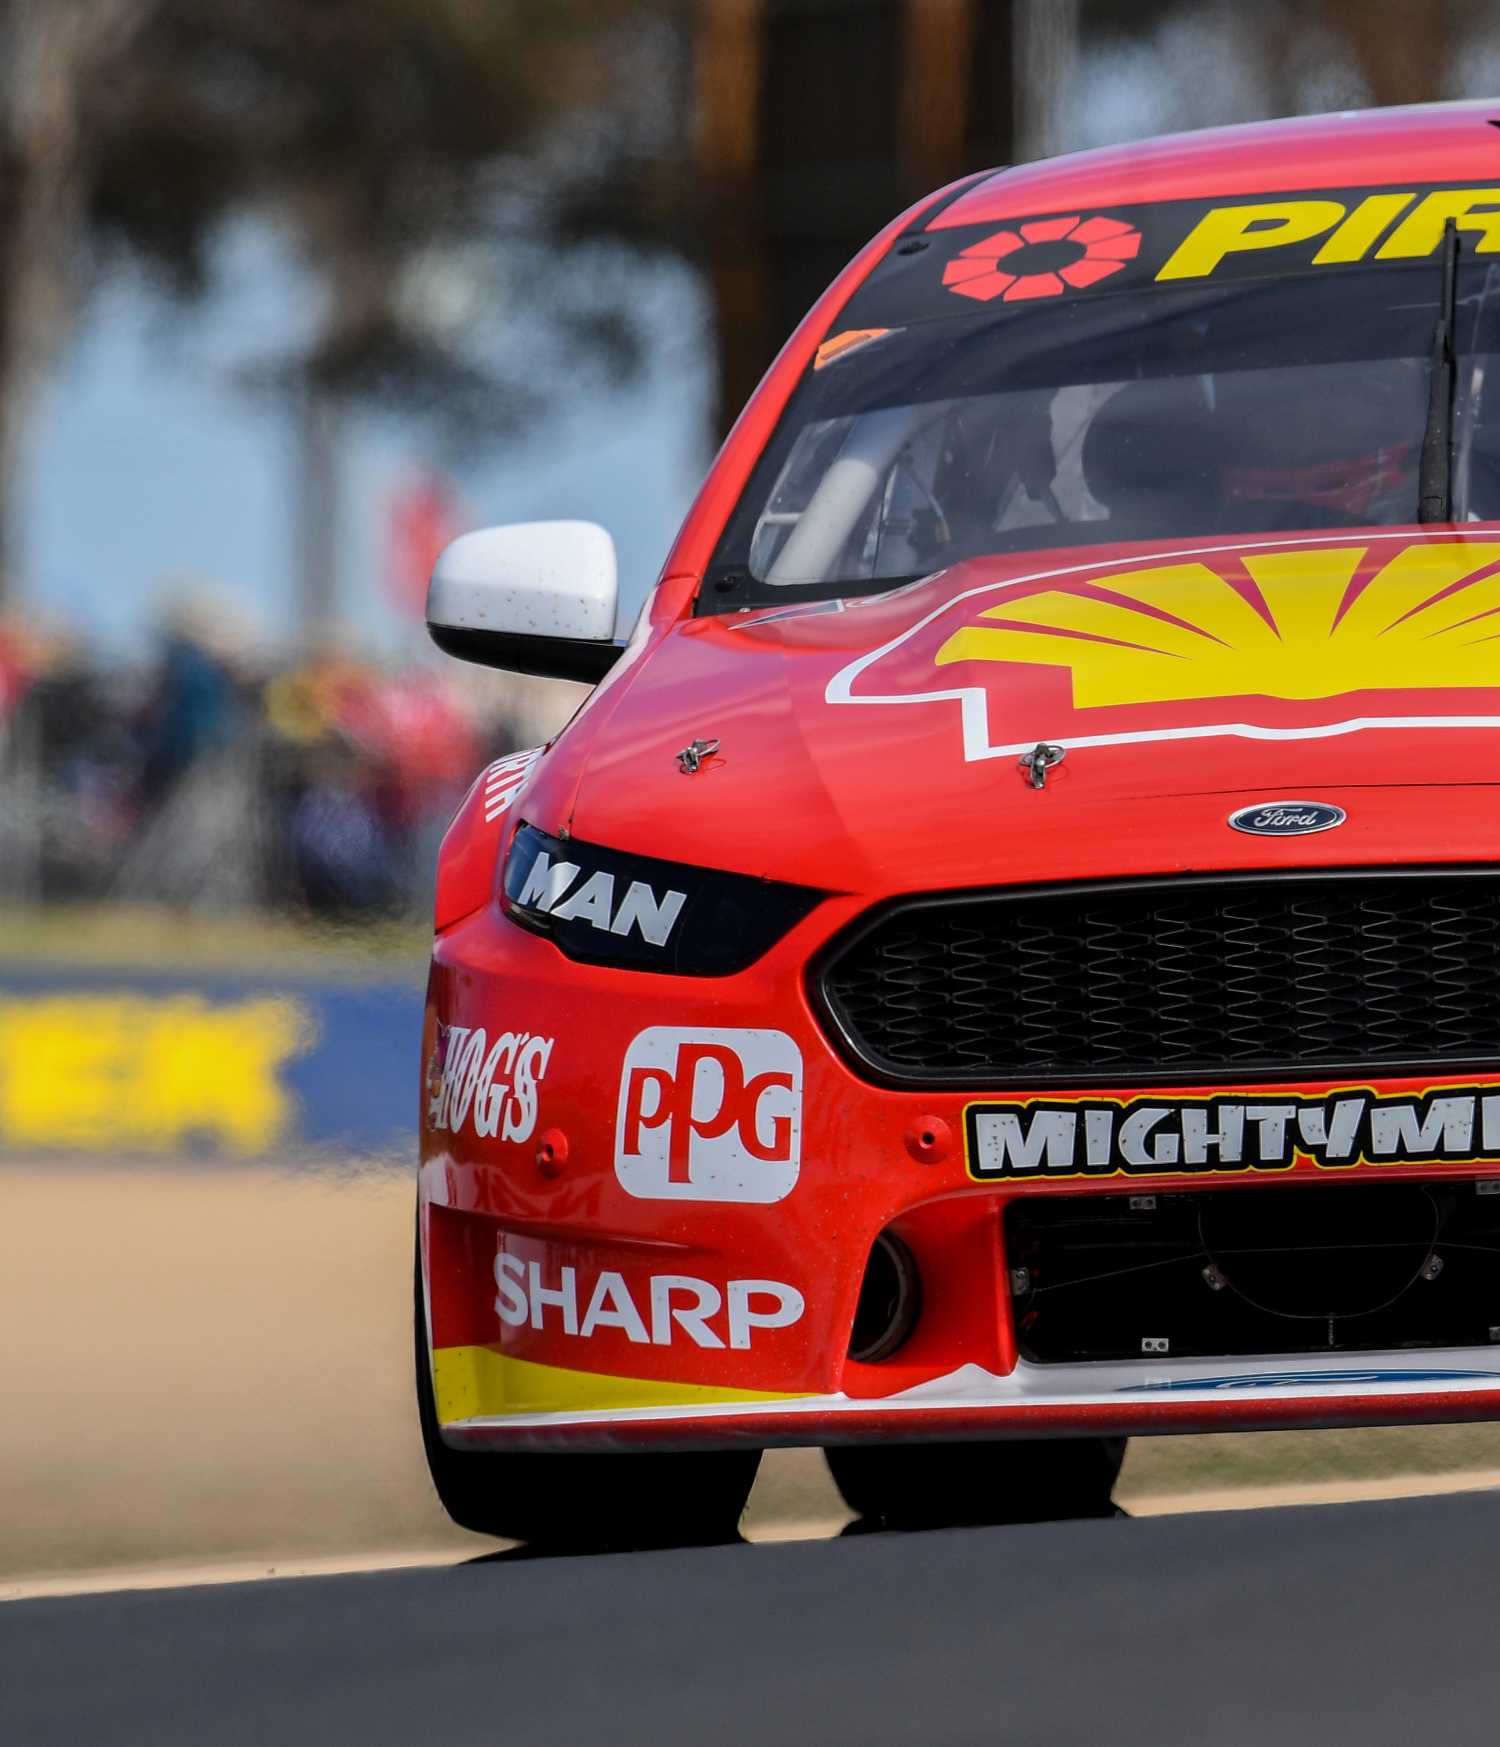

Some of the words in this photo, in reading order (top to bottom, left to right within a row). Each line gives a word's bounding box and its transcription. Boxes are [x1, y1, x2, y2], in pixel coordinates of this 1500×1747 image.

[1253, 807, 1317, 827] Ford
[517, 852, 687, 947] MAN
[434, 1026, 555, 1144] HOG'S
[622, 1042, 795, 1184] PPG
[493, 1251, 806, 1350] SHARP
